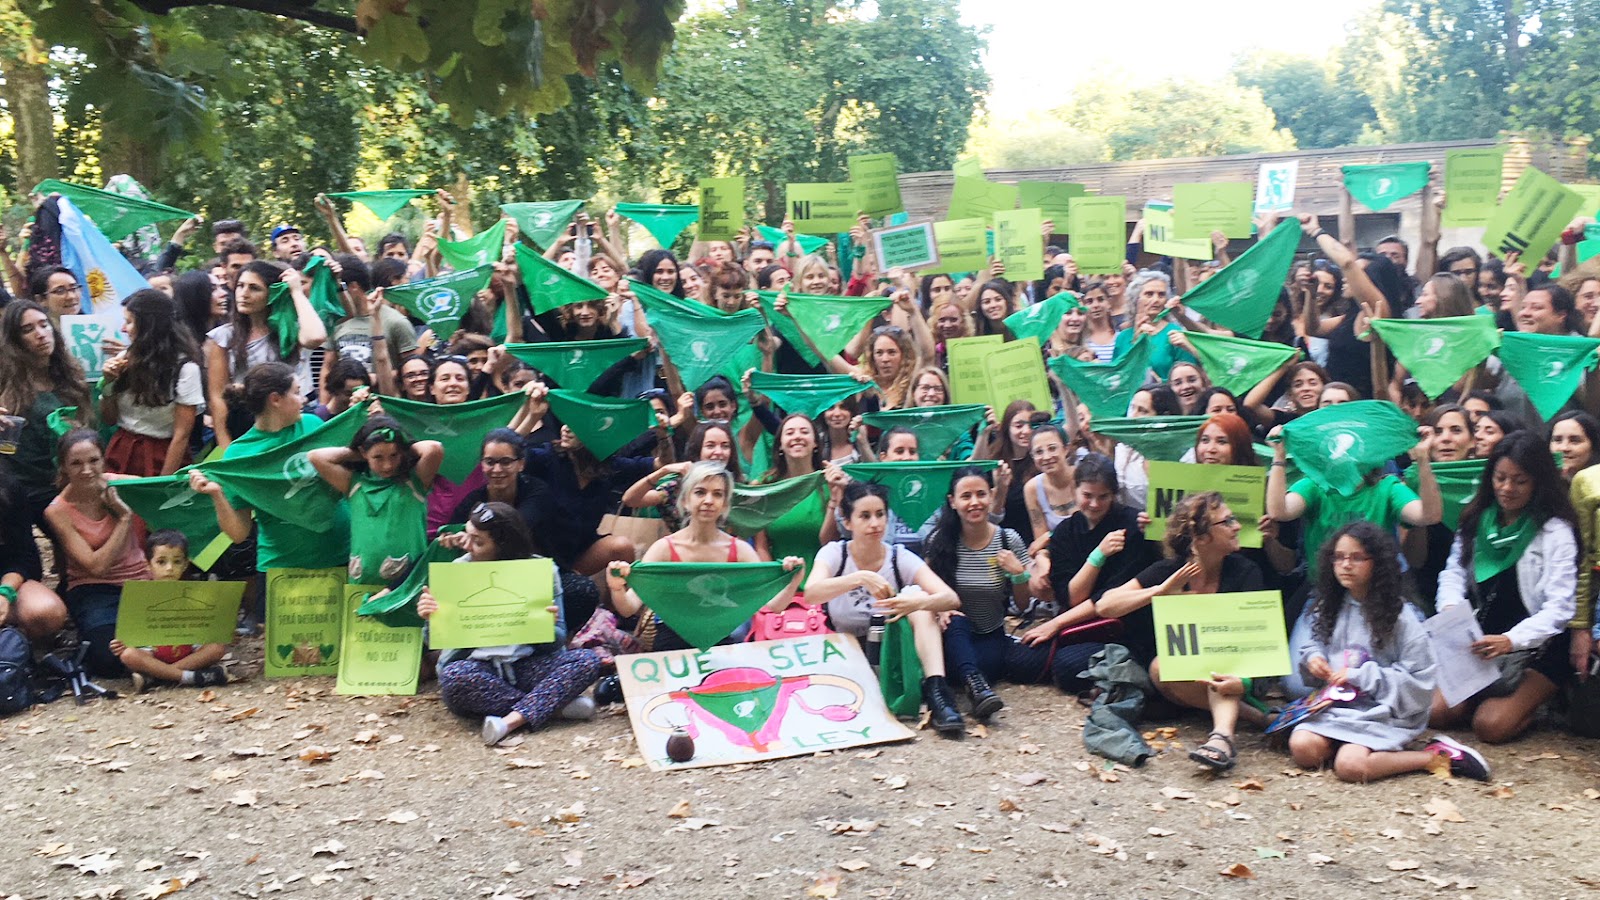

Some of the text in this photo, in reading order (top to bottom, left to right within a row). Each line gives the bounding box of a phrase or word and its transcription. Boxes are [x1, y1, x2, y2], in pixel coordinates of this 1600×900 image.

[793, 200, 810, 220] NI
[1200, 624, 1229, 634] presa
[1165, 623, 1199, 657] NI
[1203, 644, 1239, 654] muerta
[631, 640, 847, 683] QUE SEA
[792, 726, 872, 749] LEY
